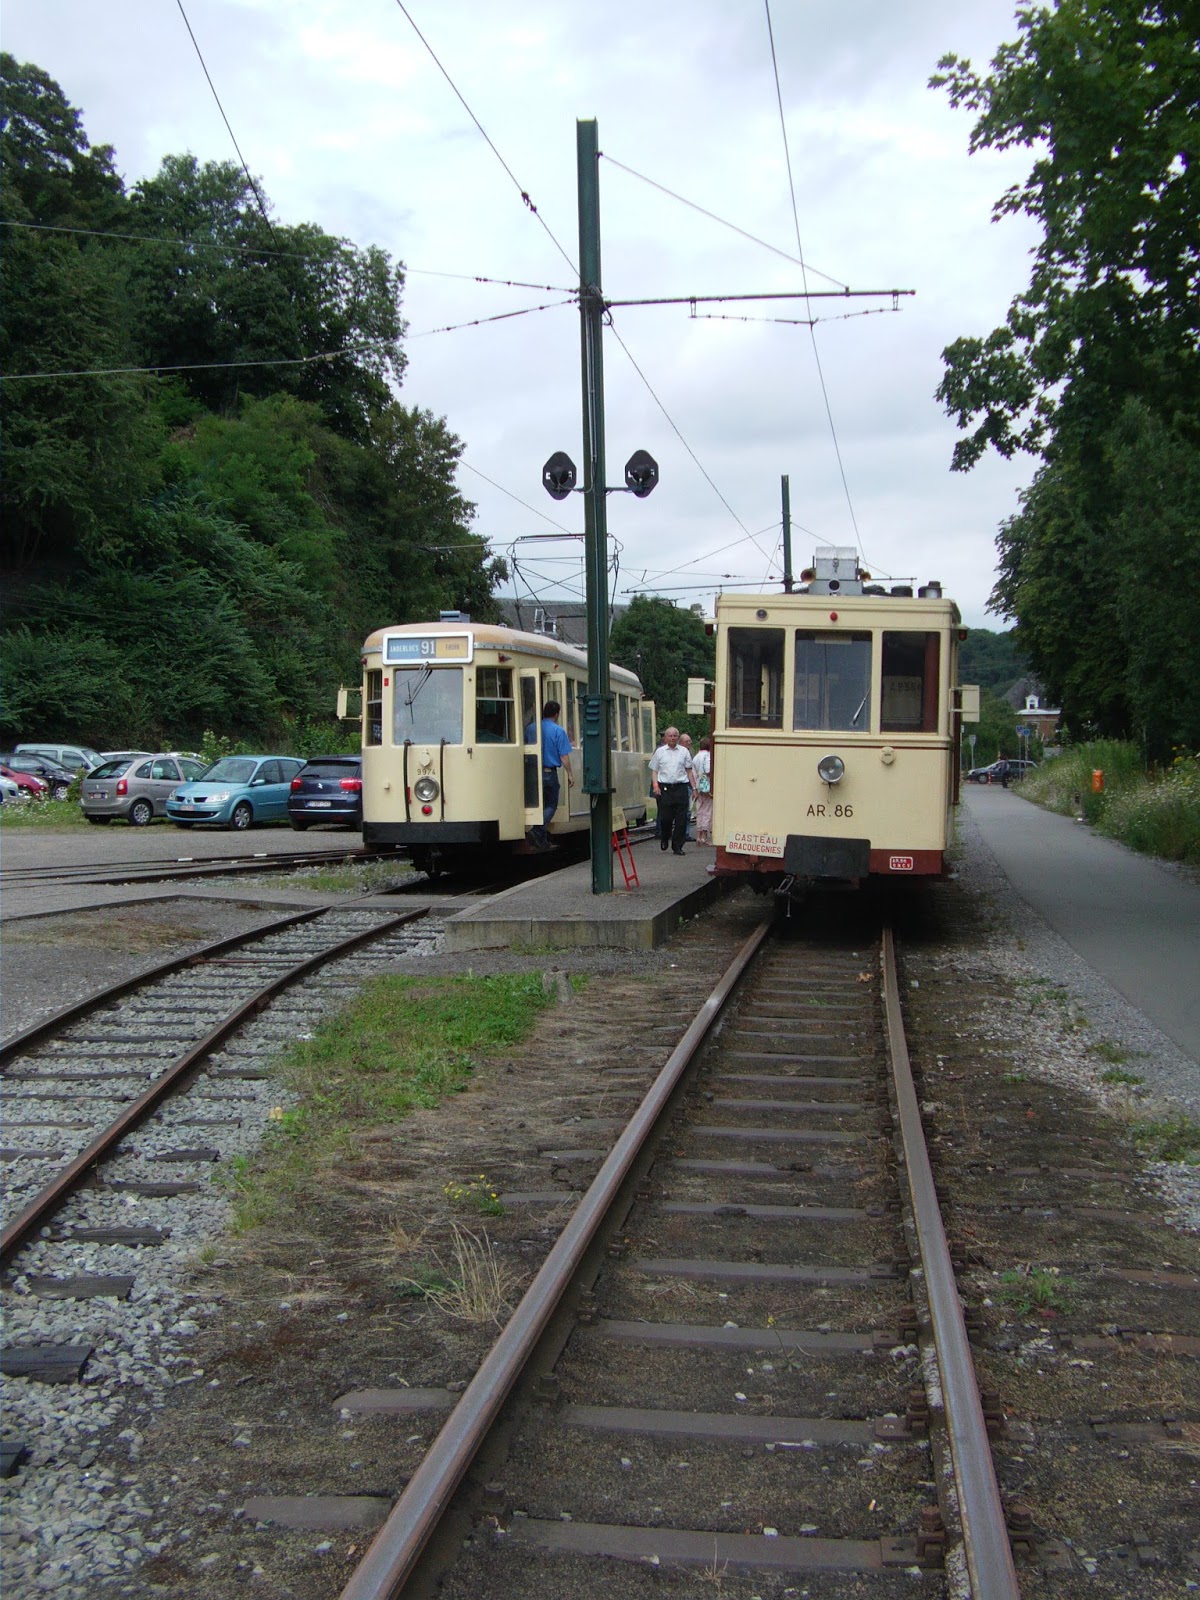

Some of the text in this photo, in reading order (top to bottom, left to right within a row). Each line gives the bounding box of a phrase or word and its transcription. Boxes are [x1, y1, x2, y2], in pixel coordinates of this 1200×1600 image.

[421, 640, 435, 655] 91
[417, 768, 436, 776] 9974
[734, 833, 778, 845] CASTEAU
[728, 841, 782, 854] BRACQUEGNIES
